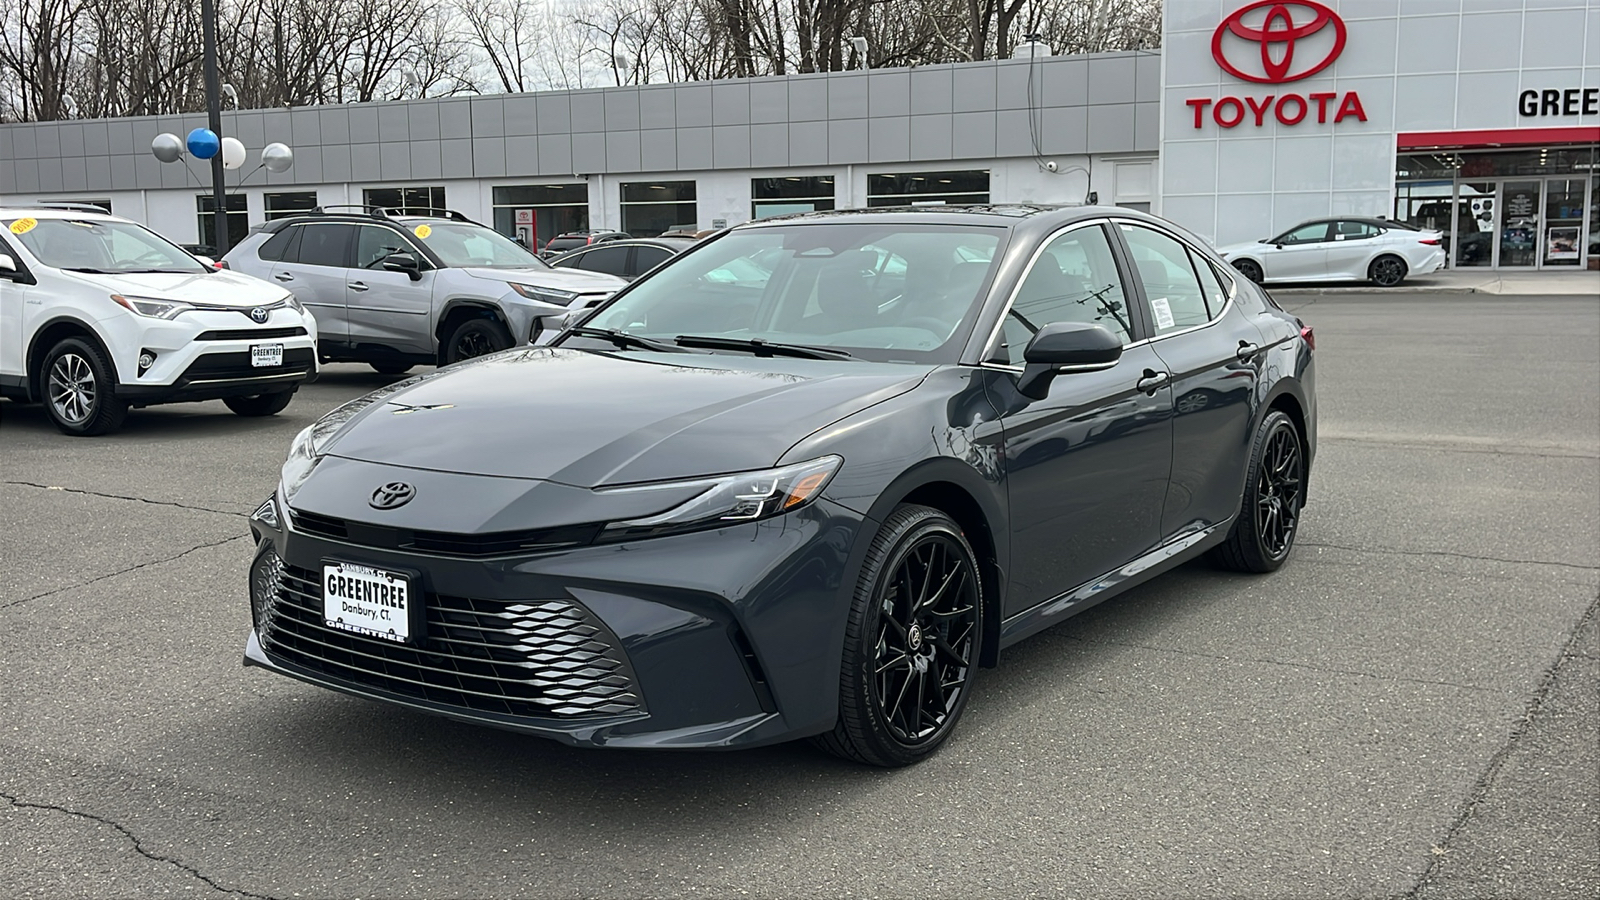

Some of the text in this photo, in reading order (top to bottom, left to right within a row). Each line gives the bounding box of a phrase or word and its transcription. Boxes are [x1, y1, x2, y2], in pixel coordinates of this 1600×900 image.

[1186, 92, 1368, 129] TOYOTA
[1519, 88, 1600, 117] GREE
[253, 348, 281, 356] GREENTREE
[327, 573, 405, 610] GREENTREE
[342, 601, 392, 621] Danbury, CT.
[325, 620, 406, 643] GREENTREE
